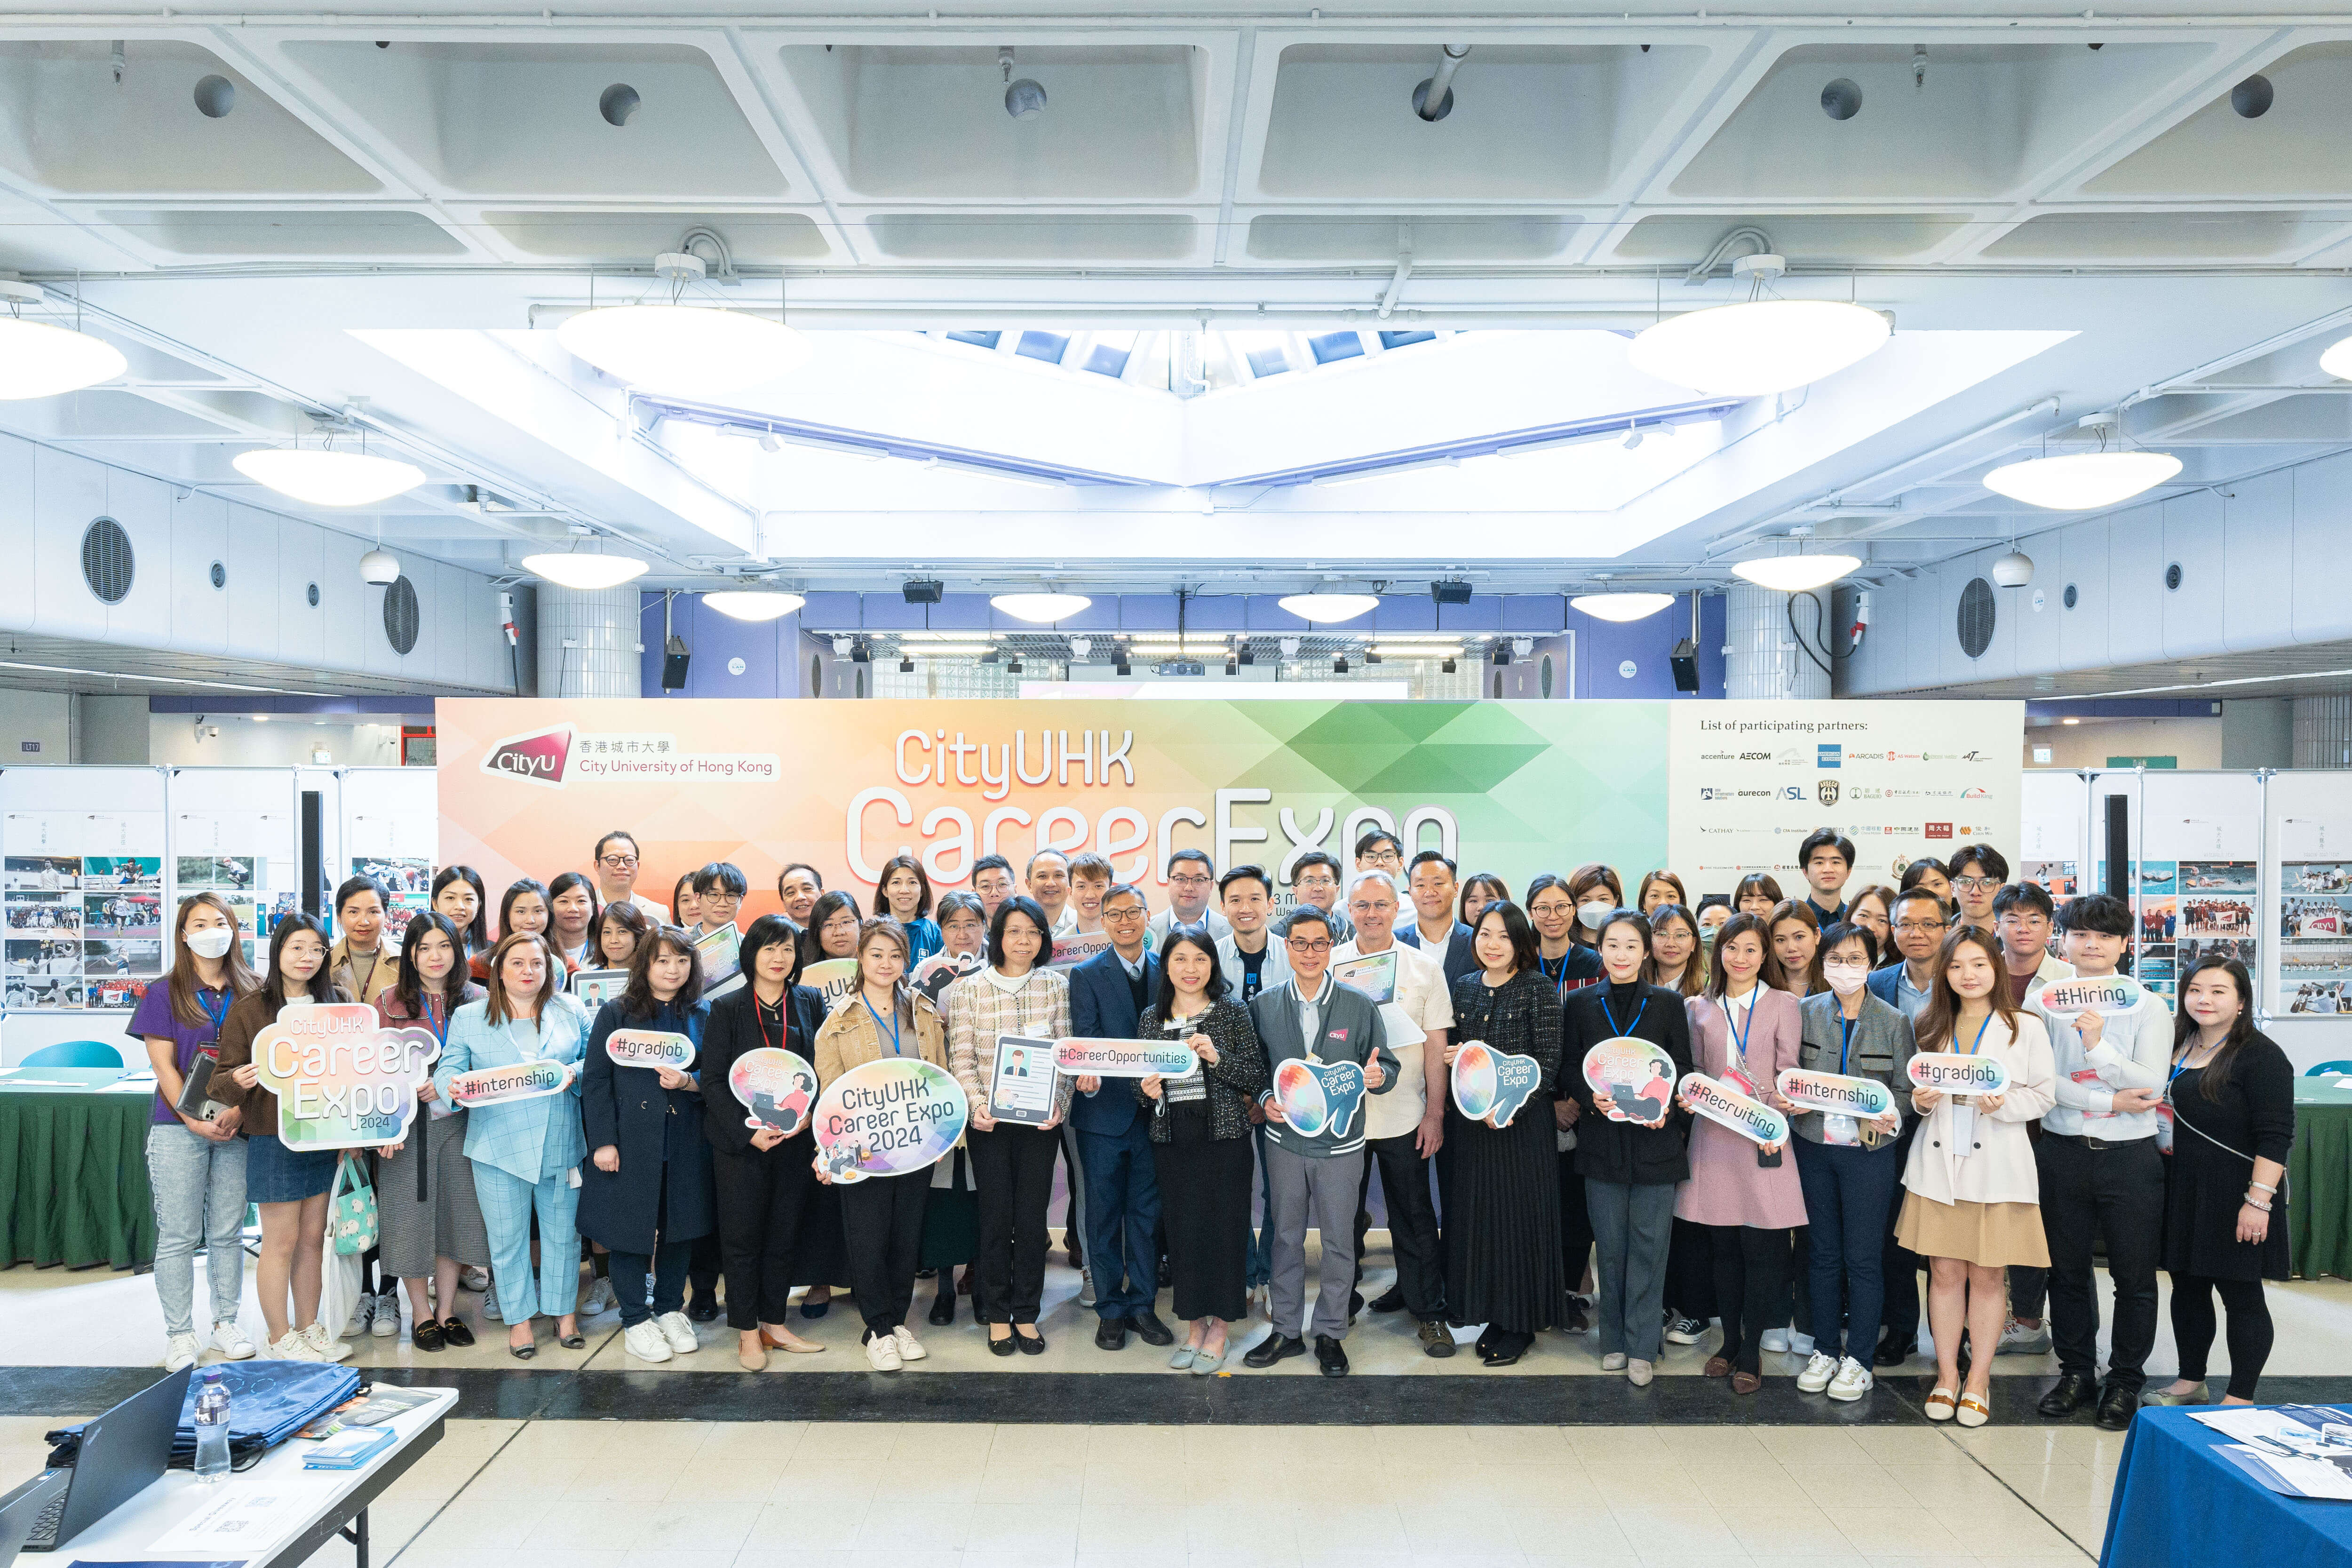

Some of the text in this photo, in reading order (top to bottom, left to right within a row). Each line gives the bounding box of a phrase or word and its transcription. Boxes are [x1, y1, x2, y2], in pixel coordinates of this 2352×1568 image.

[1700, 720, 1867, 733] List of participating partners:
[579, 740, 670, 753] 香港城市大學
[497, 752, 556, 776] CityU
[580, 760, 772, 775] City University of Hong Kong
[896, 729, 1135, 799] CityUHK
[1775, 787, 1807, 800] ASL
[2055, 987, 2126, 1006] #Hiring
[290, 1017, 364, 1038] CityUHK
[268, 1036, 424, 1078] Career
[616, 1038, 683, 1059] #gradjob
[1059, 1048, 1187, 1065] #CareerOpportunities
[1605, 1046, 1636, 1056] CityUHK
[745, 1060, 789, 1080] Career
[1597, 1053, 1644, 1068] Career
[1321, 1069, 1356, 1088] Career
[1324, 1065, 1347, 1077] CityUHK
[1497, 1065, 1534, 1076] Career
[1603, 1065, 1635, 1082] Expo
[1919, 1062, 1995, 1085] #gradjob
[465, 1070, 554, 1095] #internship
[748, 1073, 779, 1091] Expo
[1329, 1081, 1355, 1096] Expo
[1503, 1075, 1528, 1088] Expo
[842, 1077, 930, 1110] CityUHK
[1788, 1078, 1878, 1106] #internship
[294, 1078, 399, 1130] Expo
[1688, 1081, 1775, 1137] #Recruiting
[360, 1117, 390, 1129] 2024
[829, 1101, 954, 1136] Career Expo
[869, 1125, 922, 1153] 2024
